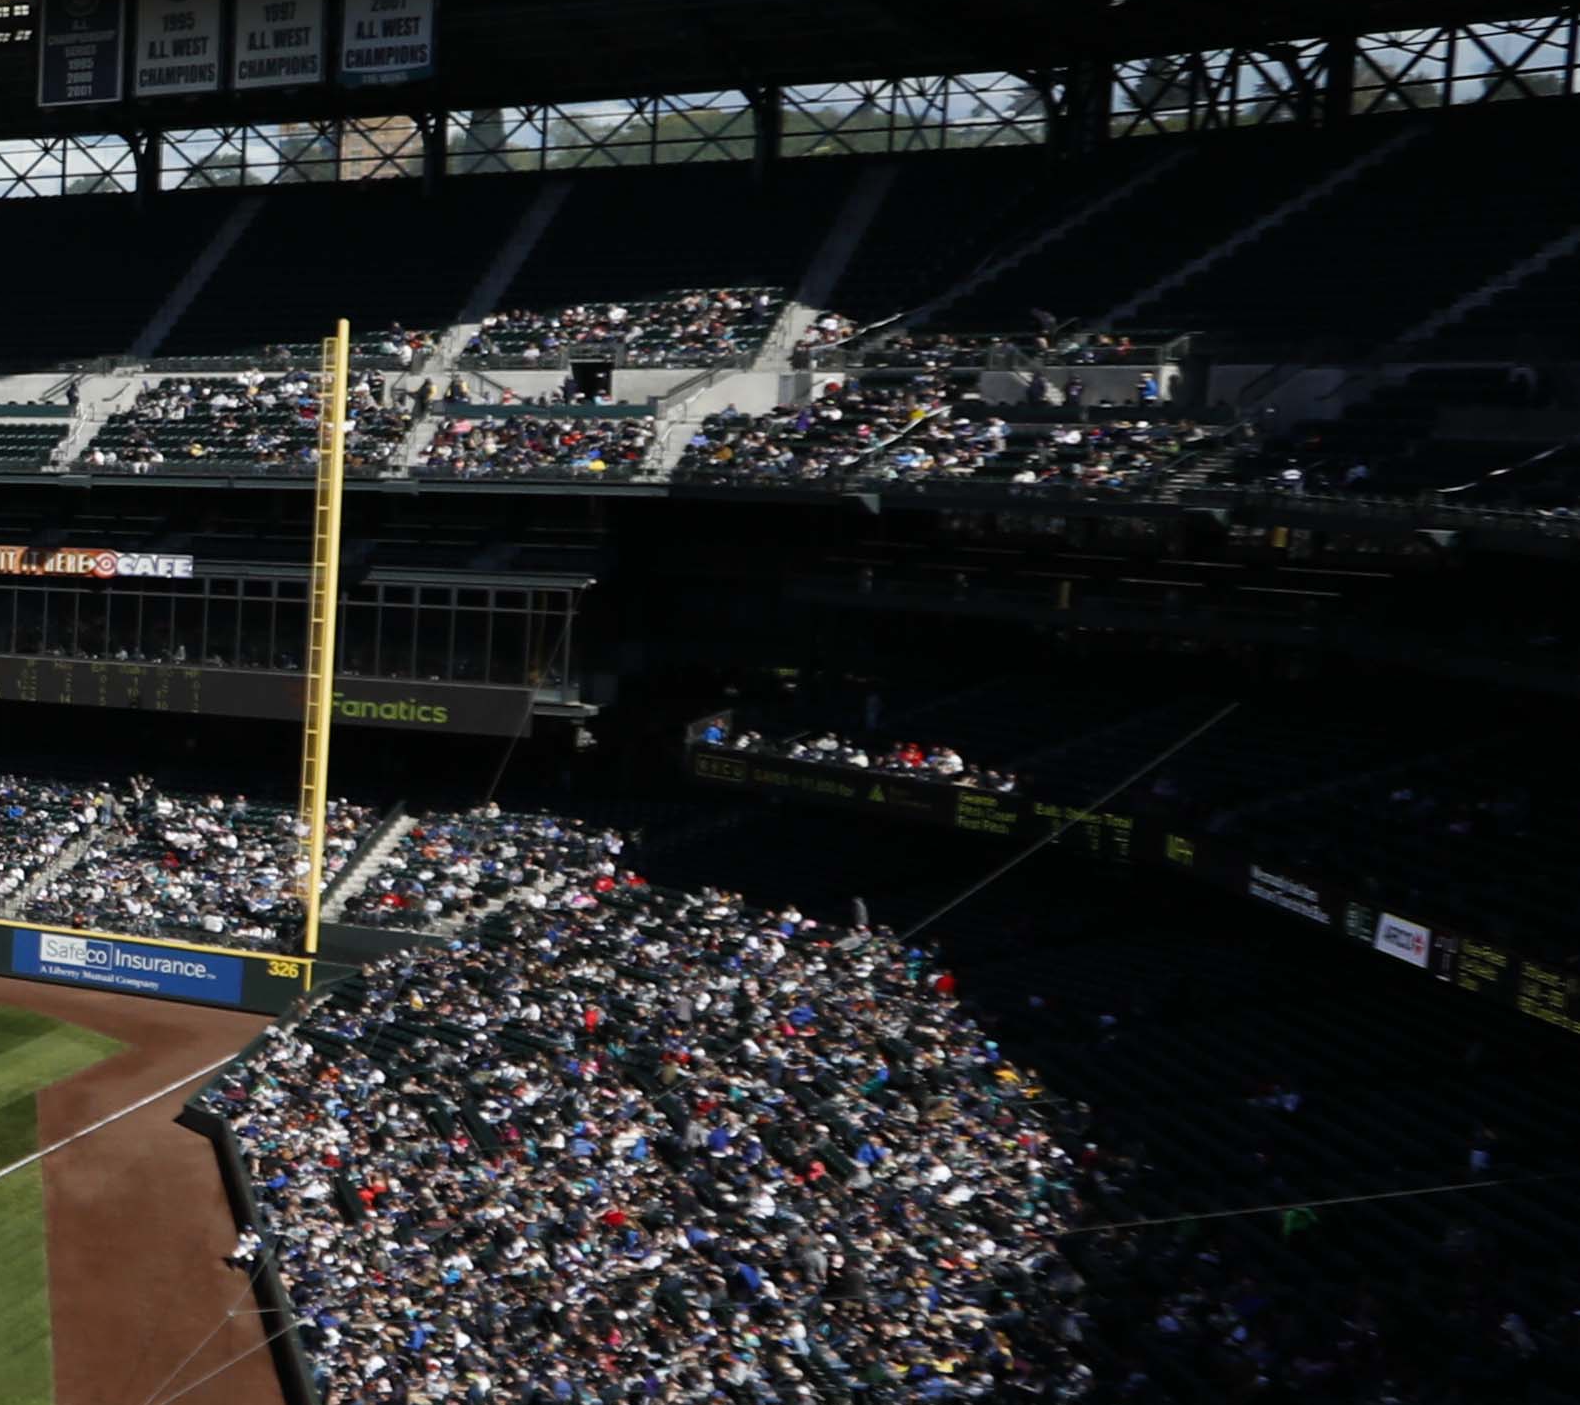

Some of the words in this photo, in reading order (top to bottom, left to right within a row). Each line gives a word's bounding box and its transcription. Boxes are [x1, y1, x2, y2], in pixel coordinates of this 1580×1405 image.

[273, 26, 311, 48] WEST
[382, 16, 421, 37] WEST
[172, 36, 210, 57] WEST
[345, 43, 429, 68] CHAMPIONS
[138, 63, 216, 88] CHAMPIONS
[238, 54, 318, 81] CHAMPIONS
[116, 555, 192, 577] CAFE
[43, 937, 108, 966] Safeco
[114, 948, 207, 980] Insurance
[267, 960, 299, 979] 326
[49, 966, 79, 981] Liberty
[83, 971, 115, 983] Mutual
[117, 975, 160, 992] Company
